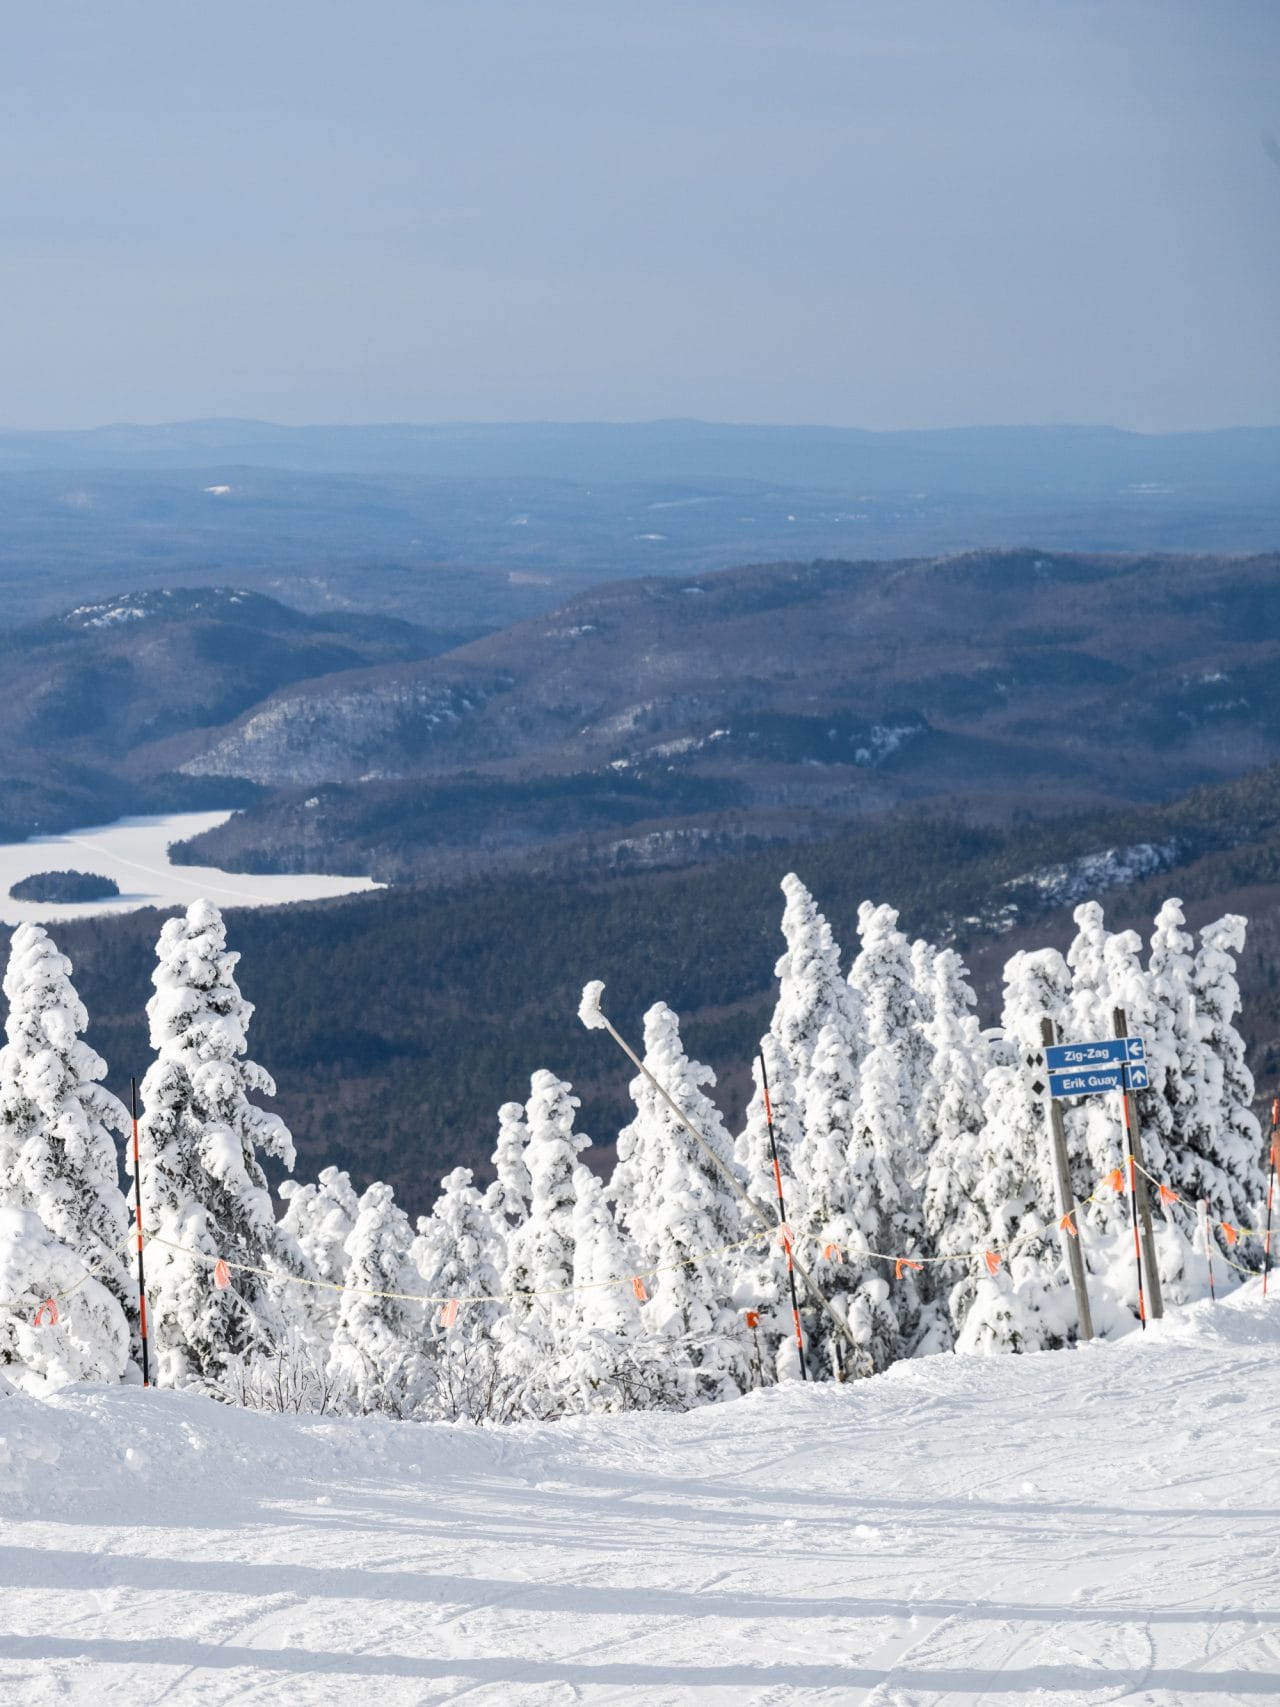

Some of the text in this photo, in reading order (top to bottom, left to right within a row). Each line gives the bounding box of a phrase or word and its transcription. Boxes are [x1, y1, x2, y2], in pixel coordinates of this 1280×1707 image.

[1064, 1048, 1109, 1062] Zig-Zag
[1063, 1076, 1118, 1089] Erik Guay
